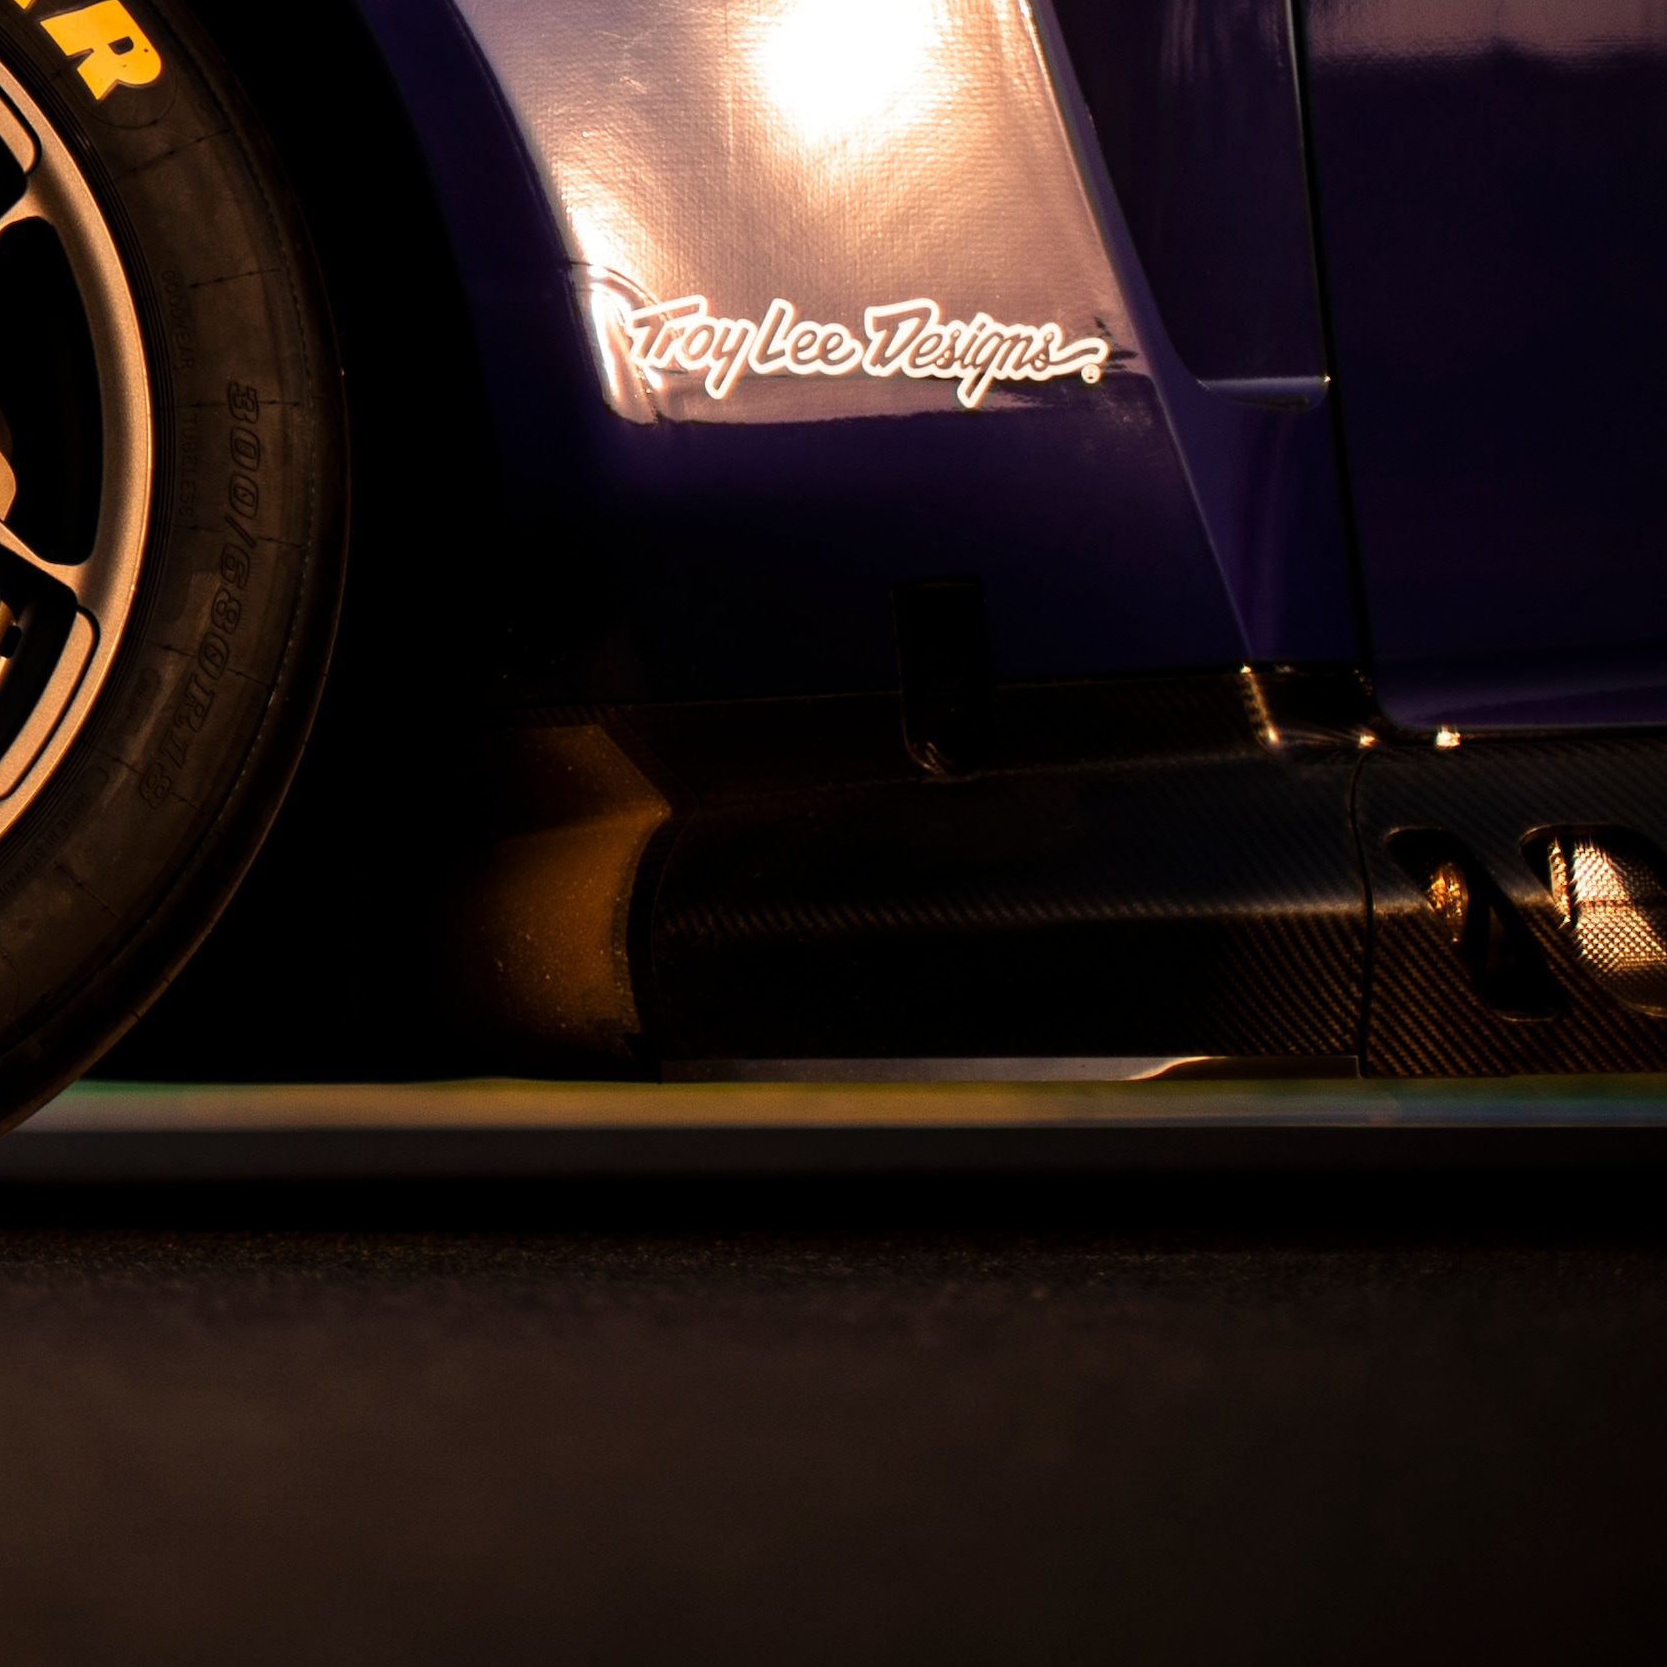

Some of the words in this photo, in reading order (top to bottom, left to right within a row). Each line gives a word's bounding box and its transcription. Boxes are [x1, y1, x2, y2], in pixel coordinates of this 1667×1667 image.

[627, 294, 751, 400] Troy
[748, 297, 860, 376] Lee
[862, 297, 1109, 408] Designs
[178, 412, 199, 518] TUBELESS
[139, 380, 261, 809] 300/680R18
[55, 790, 89, 831] MADE
